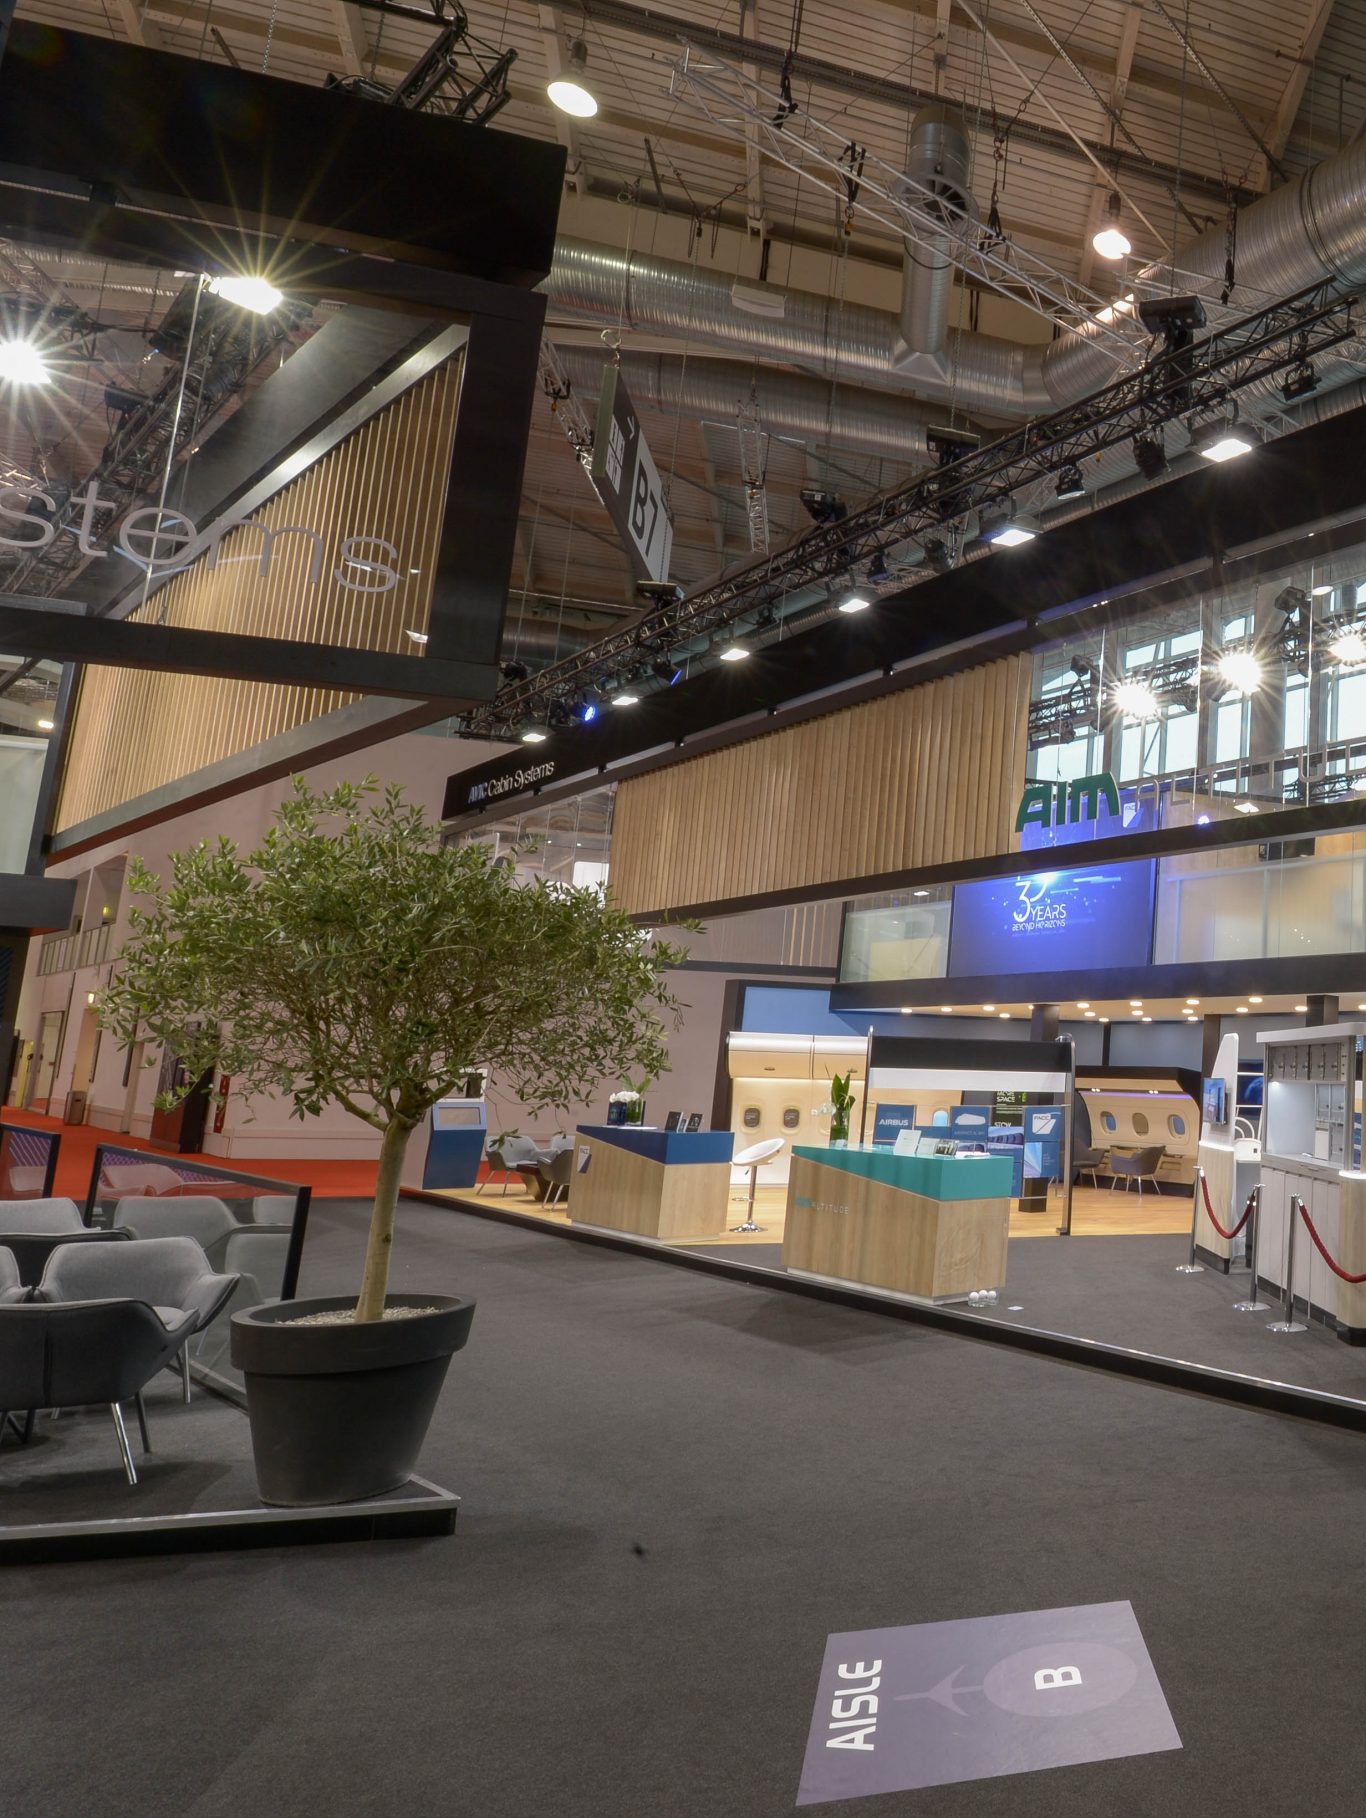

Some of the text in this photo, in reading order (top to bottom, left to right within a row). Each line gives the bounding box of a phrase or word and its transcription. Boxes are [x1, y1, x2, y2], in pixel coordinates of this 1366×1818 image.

[468, 761, 555, 804] AVIC Cabin Systems
[1015, 772, 1121, 833] AIM
[1030, 904, 1066, 920] YEARS
[1036, 919, 1066, 928] HORIZONS
[878, 1118, 909, 1126] AIRBUS
[1034, 1665, 1083, 1690] B
[826, 1659, 882, 1751] AISLE
